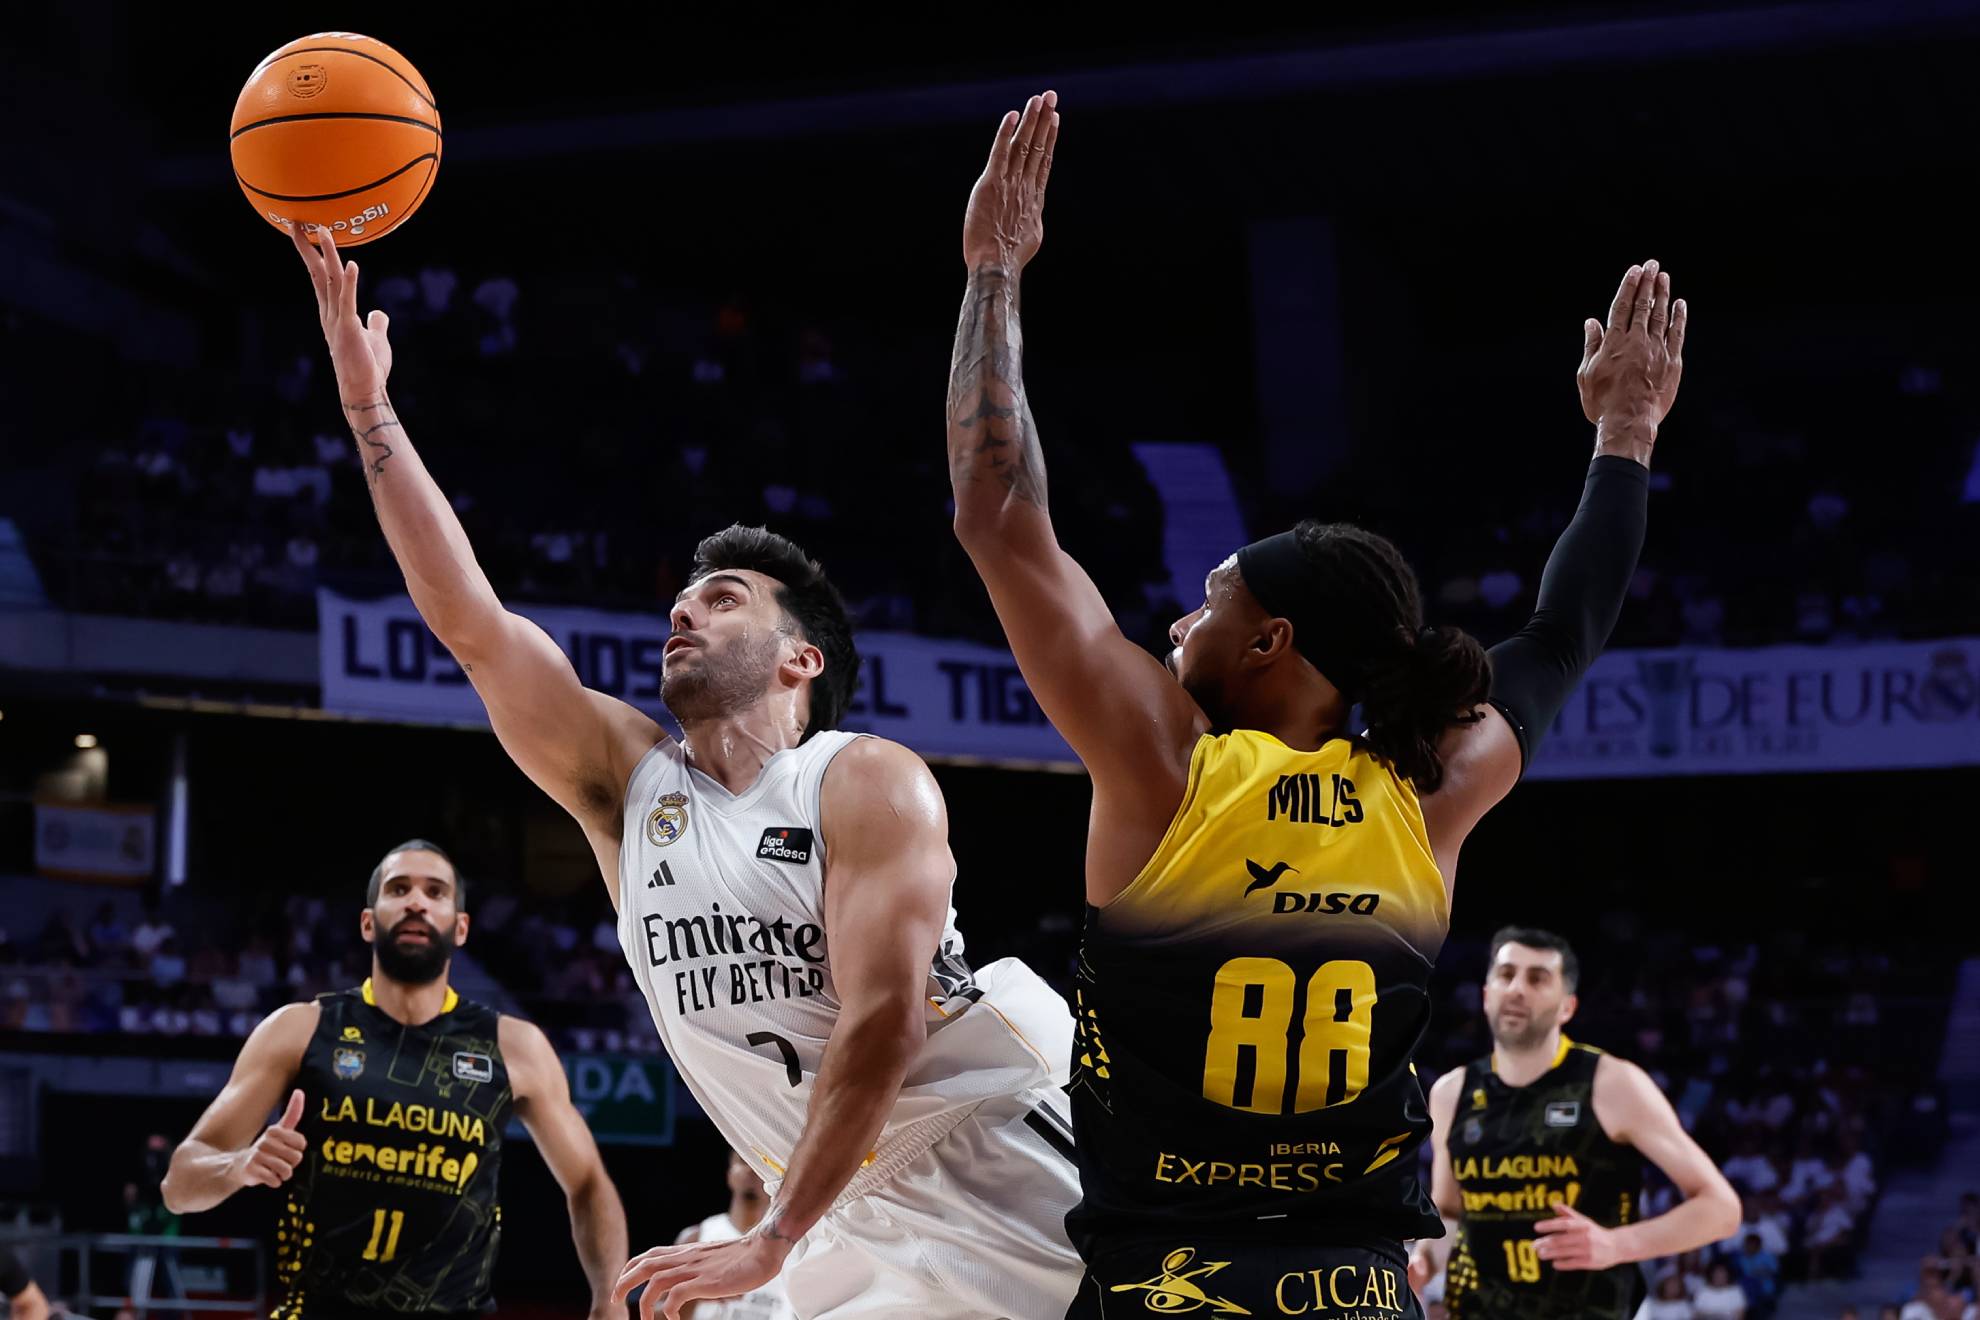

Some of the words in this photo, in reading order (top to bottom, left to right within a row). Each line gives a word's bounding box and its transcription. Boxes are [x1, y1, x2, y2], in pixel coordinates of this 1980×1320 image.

[349, 203, 389, 227] liga
[937, 660, 1050, 725] TIG
[1552, 674, 1646, 736] ES
[1267, 773, 1364, 827] MILLS
[760, 847, 807, 860] endesa
[763, 836, 784, 847] liga
[675, 966, 717, 1016] FLY
[573, 1058, 656, 1104] DA
[746, 1031, 802, 1088] 7
[321, 1096, 358, 1122] LA
[366, 1098, 486, 1146] LAGUNA
[1155, 1152, 1344, 1192] EXPRESS
[1270, 1142, 1341, 1156] IBERIA
[1454, 1156, 1479, 1180] LA
[1482, 1155, 1579, 1179] LAGUNA
[362, 1209, 404, 1263] 11
[1503, 1239, 1540, 1283] 19
[1275, 1265, 1403, 1315] CICAR
